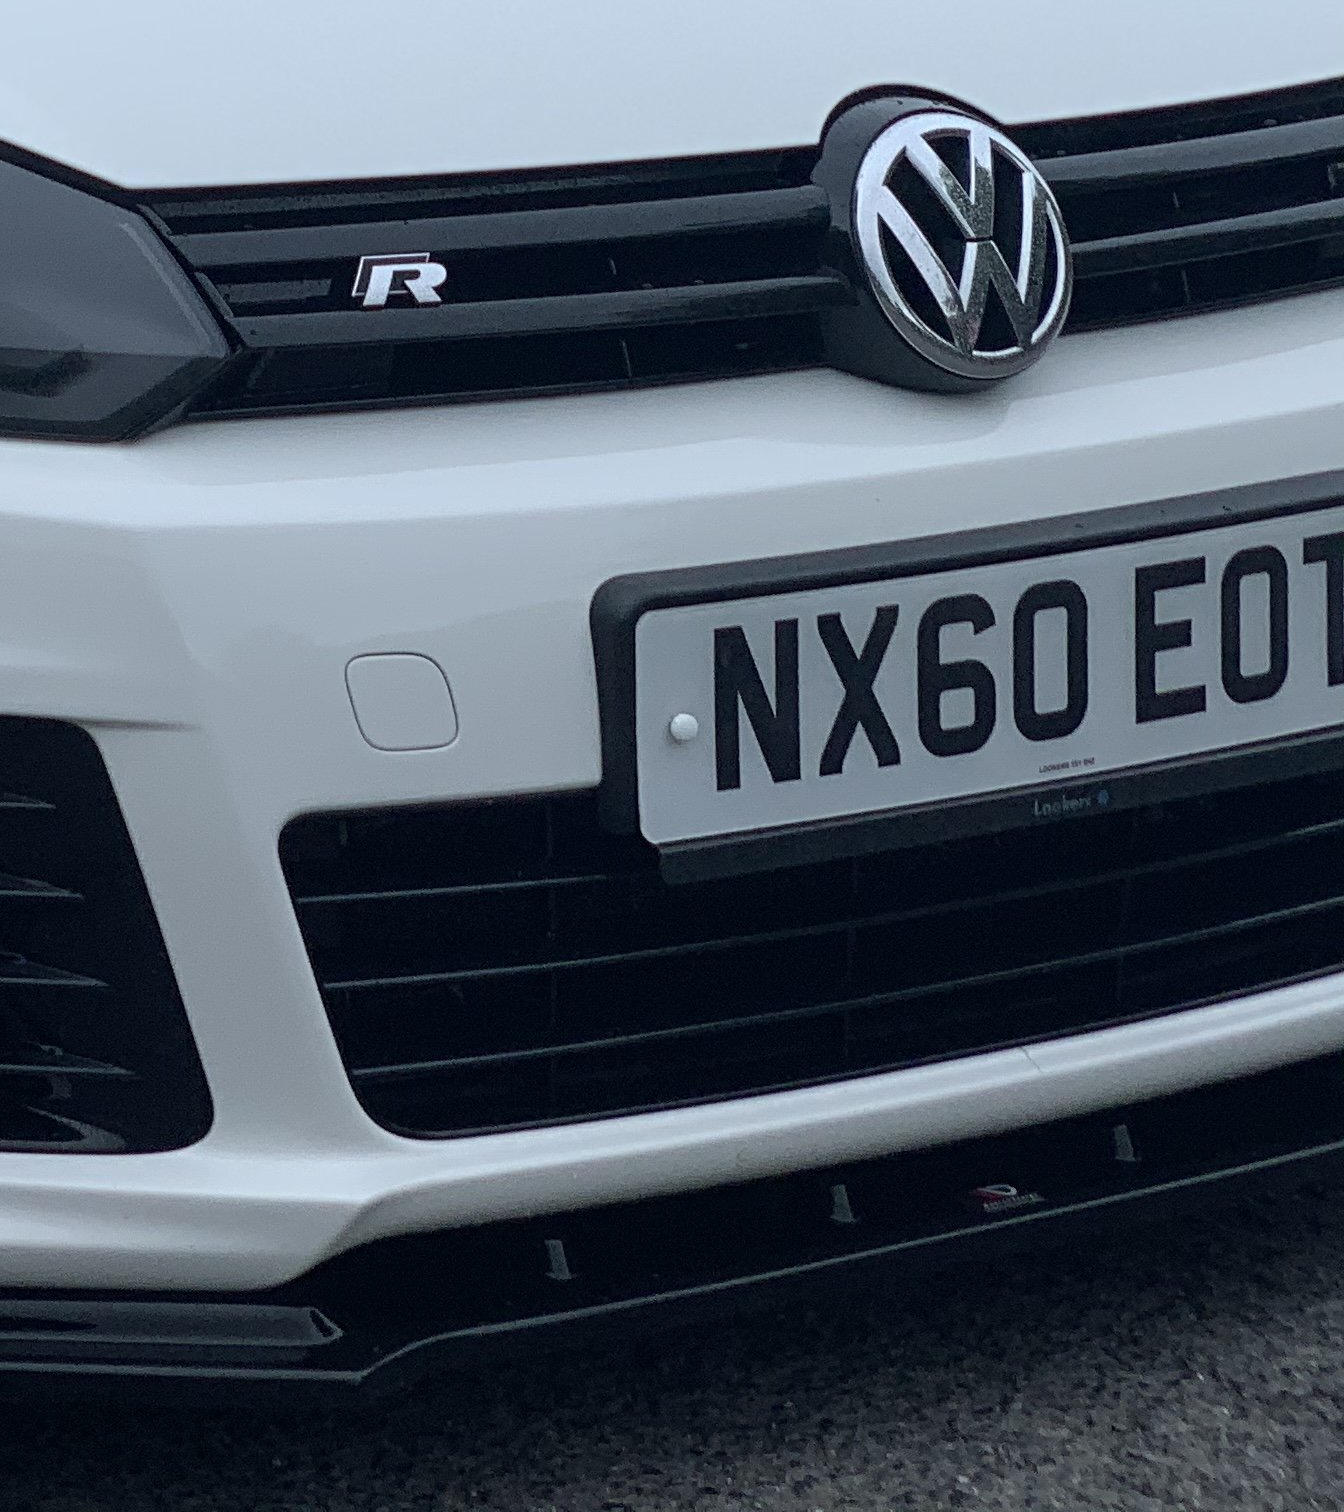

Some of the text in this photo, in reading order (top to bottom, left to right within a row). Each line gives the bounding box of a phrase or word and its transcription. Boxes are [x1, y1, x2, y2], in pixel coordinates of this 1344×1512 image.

[356, 254, 448, 308] R
[713, 531, 1344, 791] NX60 EOT
